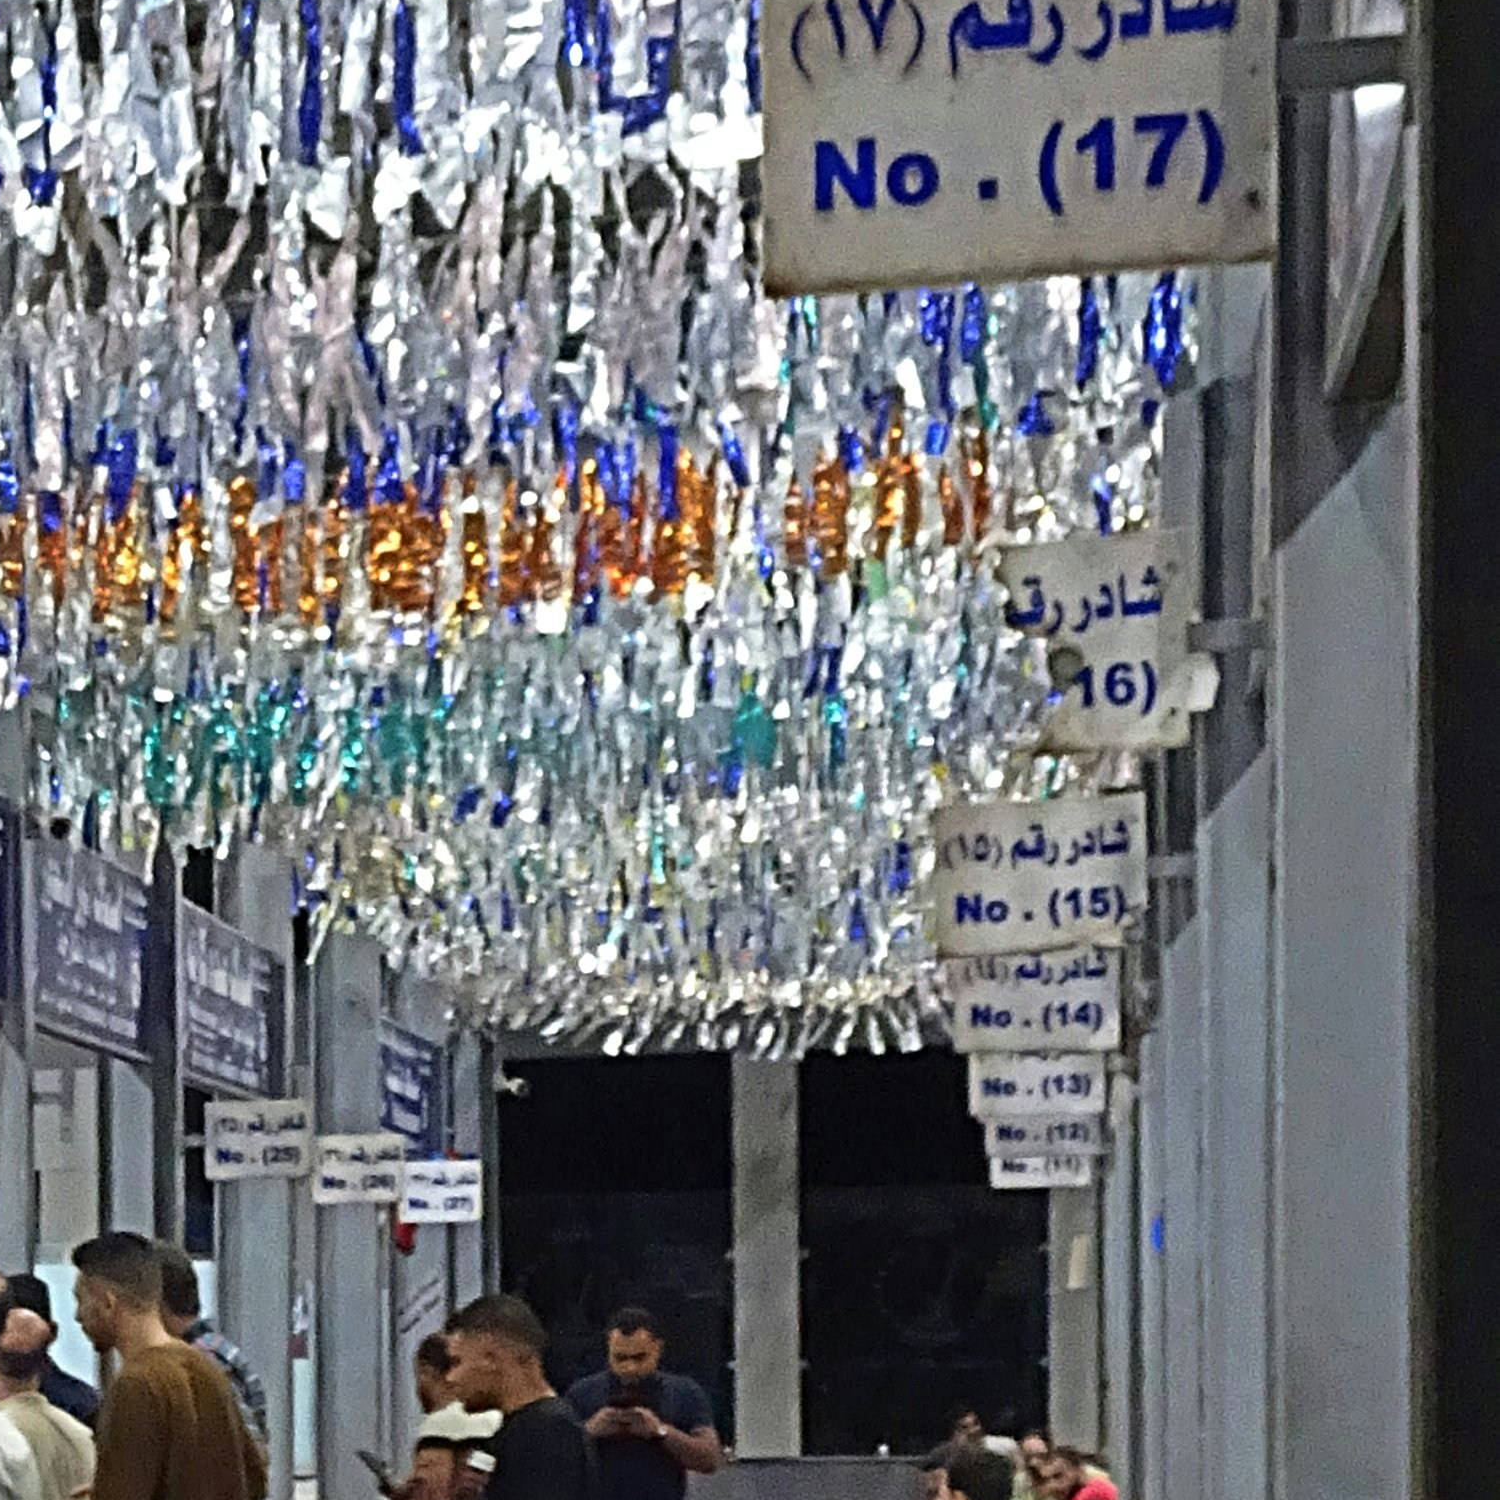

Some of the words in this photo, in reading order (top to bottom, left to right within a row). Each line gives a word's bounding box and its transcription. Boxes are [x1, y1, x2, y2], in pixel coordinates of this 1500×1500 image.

[1038, 106, 1226, 217] (17)
[1073, 564, 1164, 634] شادر
[1074, 659, 1157, 717] 16)
[1010, 823, 1060, 871] رقم
[1064, 818, 1130, 866] شادر
[1048, 884, 1126, 929] (15)
[1041, 1001, 1103, 1034] (14)
[1041, 1073, 1092, 1100] (13)
